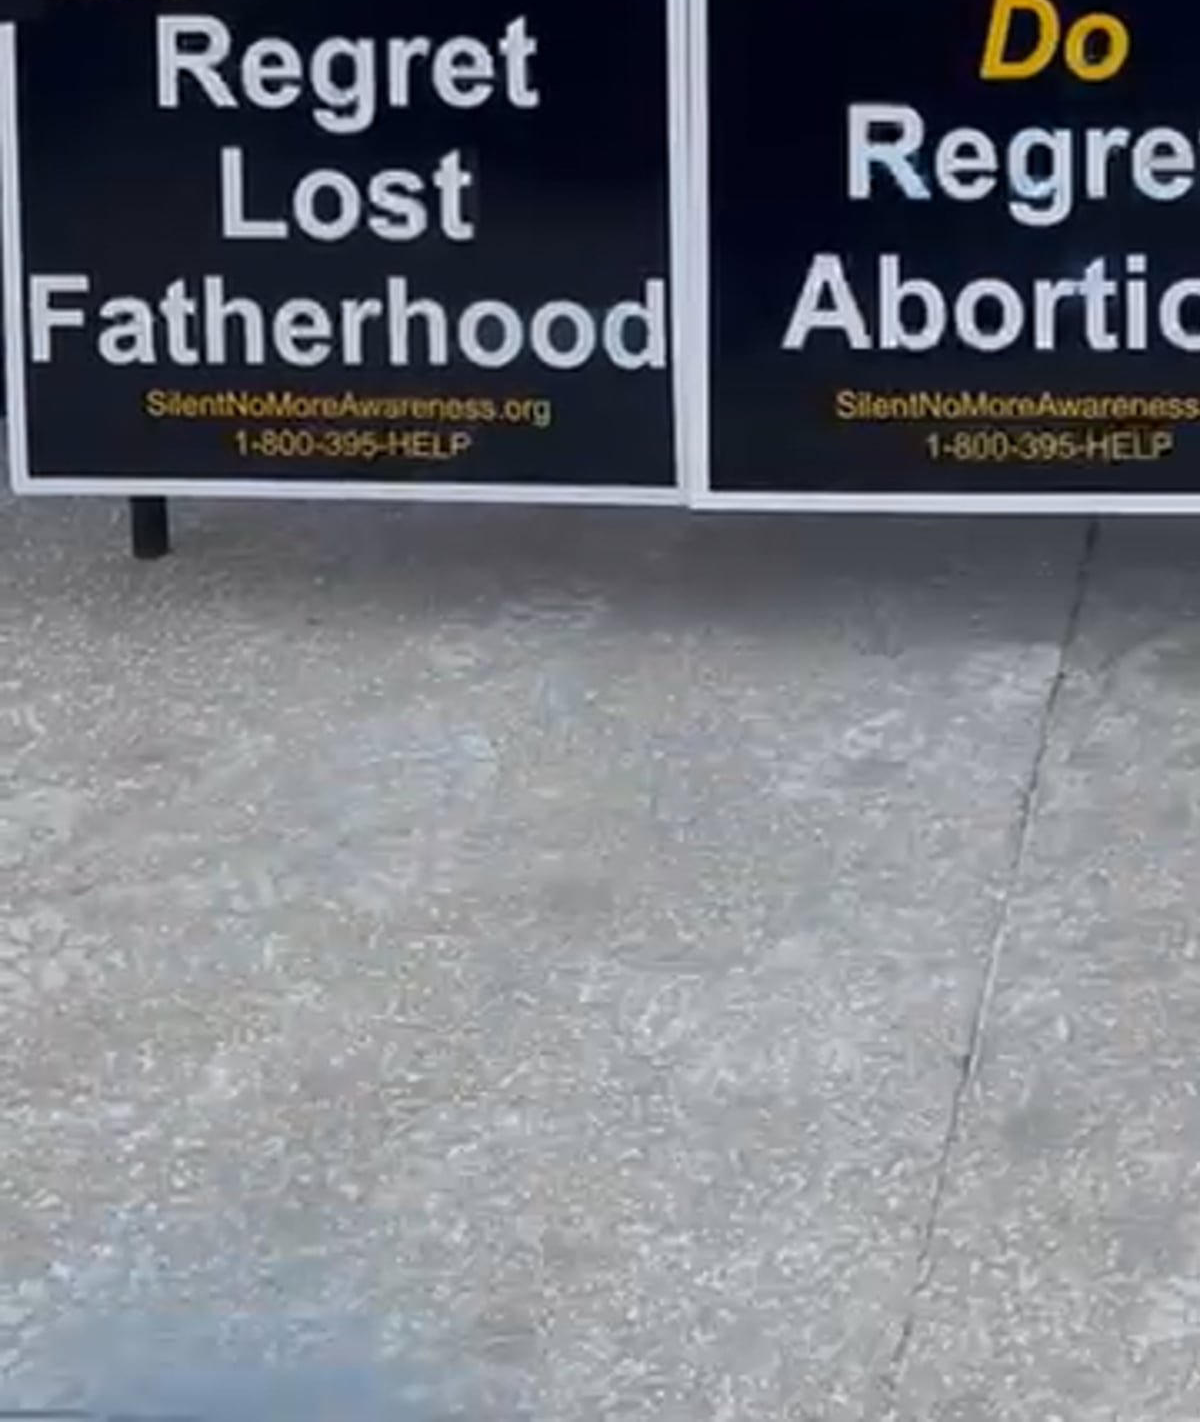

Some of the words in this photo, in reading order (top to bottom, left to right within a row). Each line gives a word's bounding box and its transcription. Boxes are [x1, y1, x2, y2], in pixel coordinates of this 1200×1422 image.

[156, 14, 540, 134] Regret
[221, 146, 474, 241] Lost
[29, 274, 667, 370] Fatherhood
[146, 389, 551, 428] SilentNoMoreAwareness.org
[235, 428, 472, 459] 1-800-395-HELP
[926, 430, 1173, 462] 1-800-395-HELP
